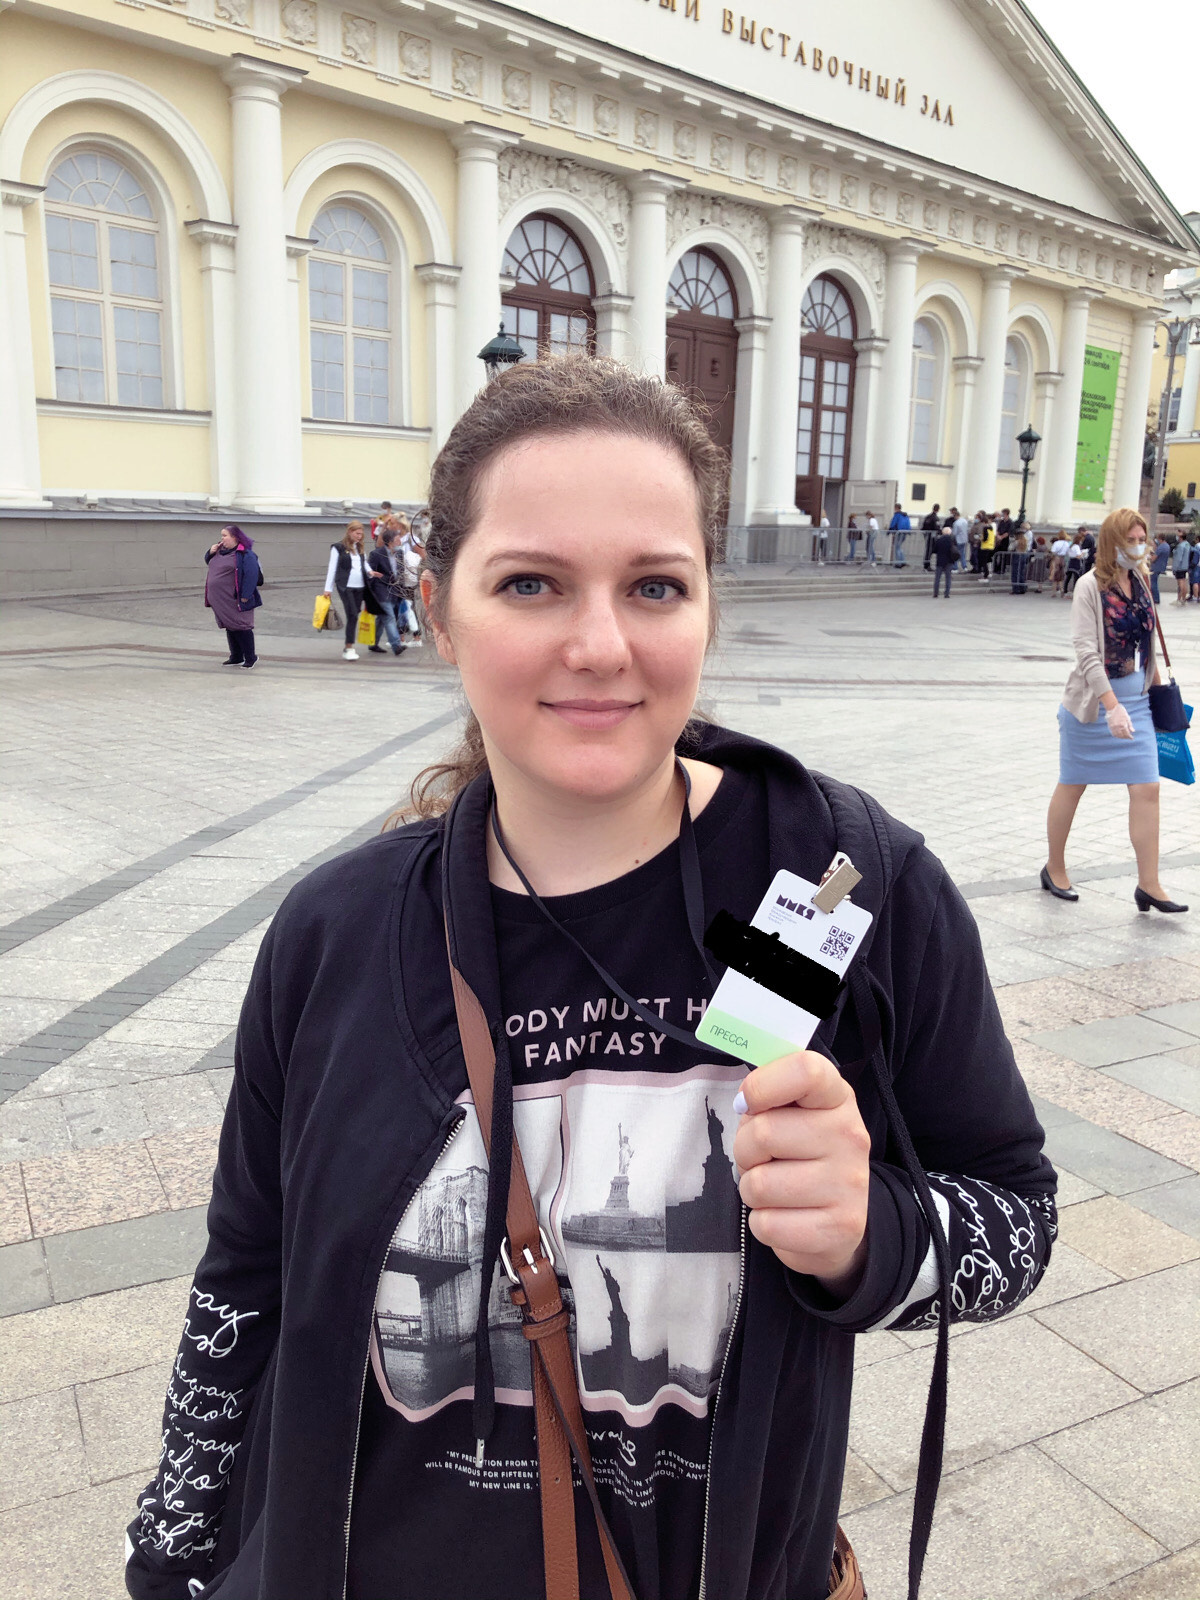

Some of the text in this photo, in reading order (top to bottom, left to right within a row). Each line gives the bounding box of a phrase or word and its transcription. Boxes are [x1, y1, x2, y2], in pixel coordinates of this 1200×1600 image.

[721, 8, 907, 107] ВЫСТАВОЧНЫЙ
[920, 94, 955, 127] ЗАЛ
[505, 1005, 571, 1037] ODY
[582, 998, 671, 1023] MUST
[524, 1031, 667, 1068] FANTASY
[709, 1024, 749, 1049] ПРЕССА
[454, 1463, 481, 1477] FAMOUS
[483, 1470, 498, 1478] FOR
[501, 1470, 533, 1479] FIFTEEN
[469, 1480, 480, 1488] MY
[503, 1482, 521, 1490] LINE
